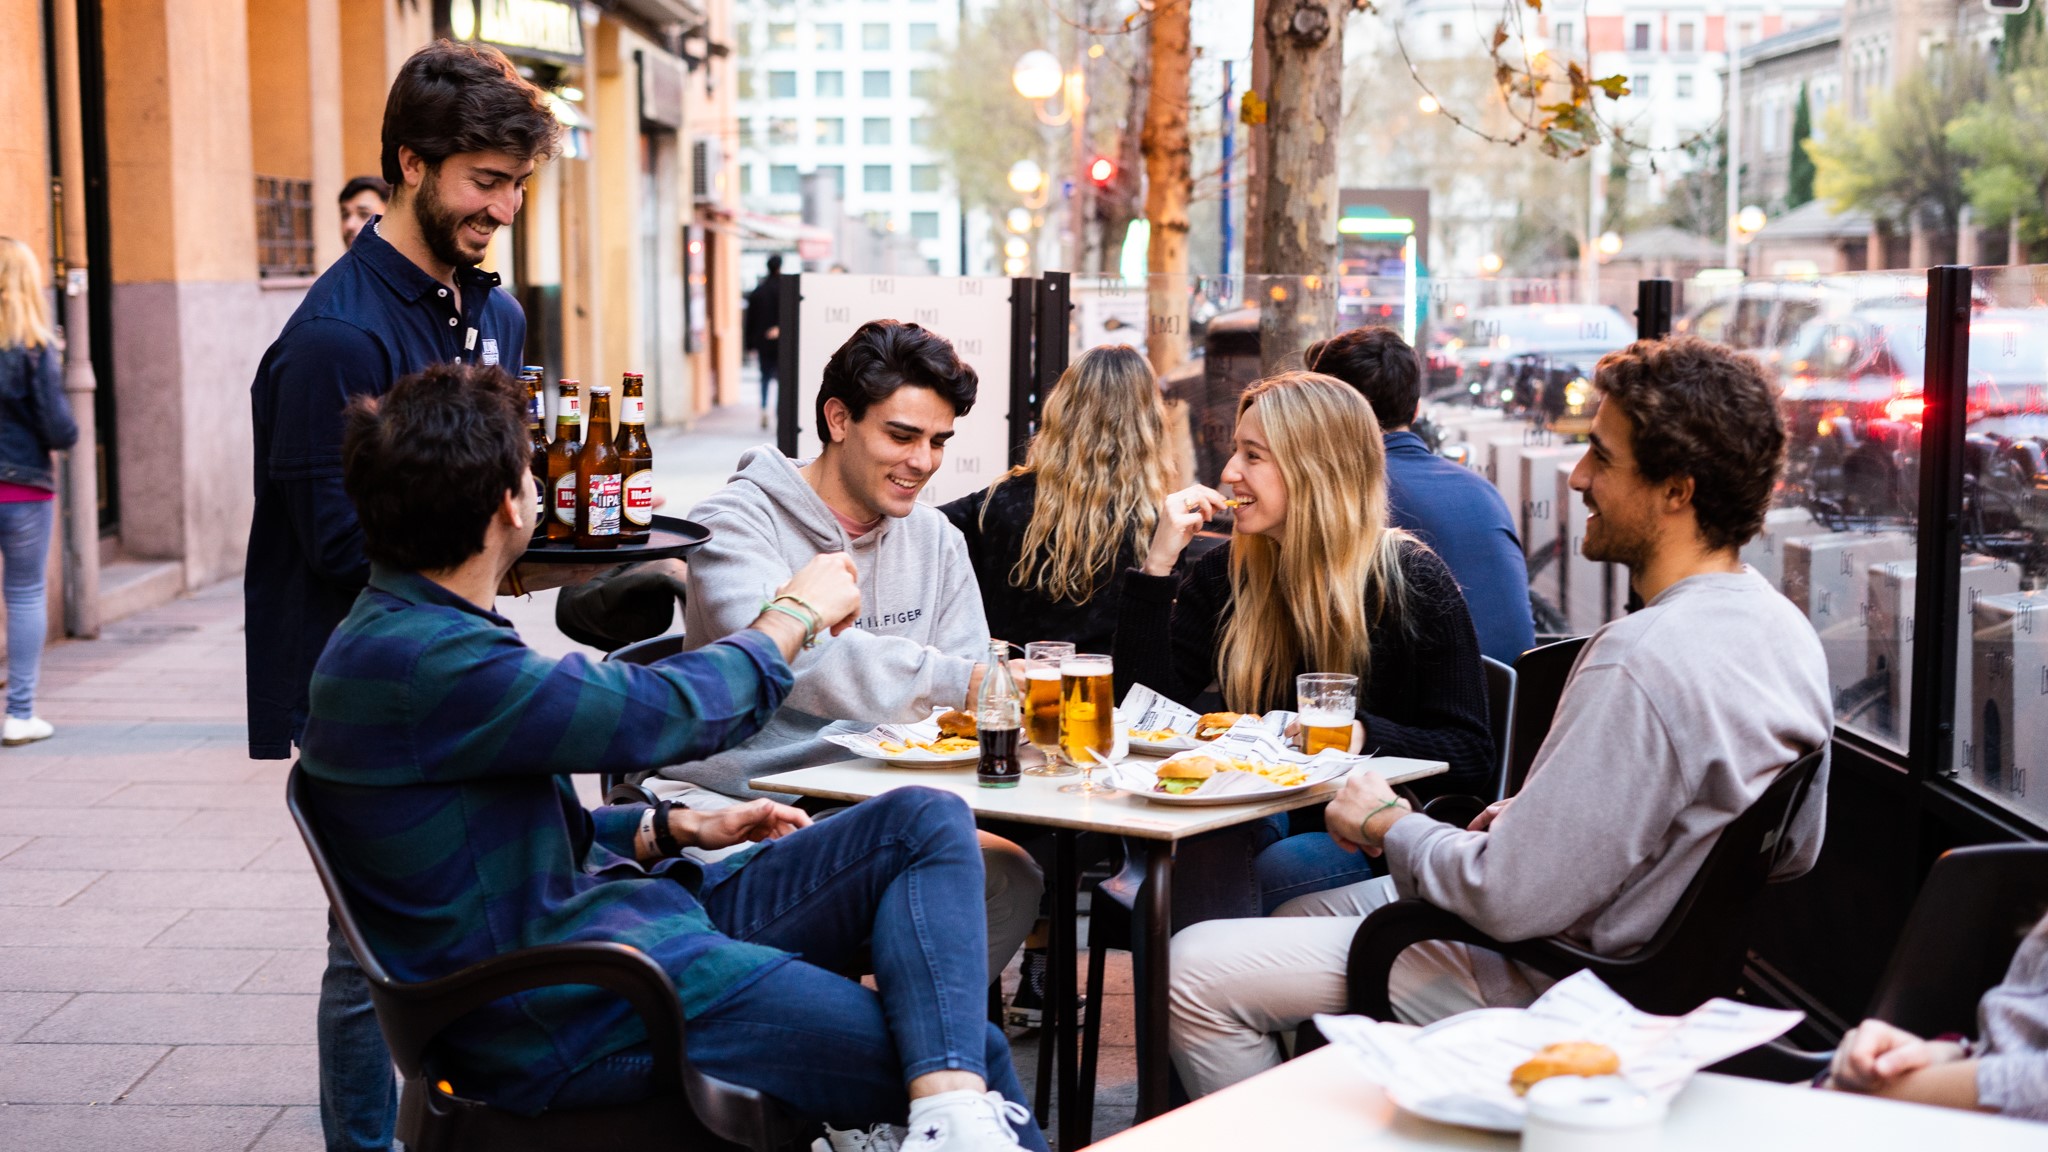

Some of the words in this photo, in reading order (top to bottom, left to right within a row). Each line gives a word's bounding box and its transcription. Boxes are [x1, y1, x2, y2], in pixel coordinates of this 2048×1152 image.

[870, 279, 895, 294] [M]
[959, 280, 983, 295] [M]
[825, 307, 849, 323] [M]
[914, 309, 939, 324] [M]
[1151, 314, 1180, 335] [M]
[1578, 320, 1608, 339] [M]
[958, 339, 982, 355] [M]
[956, 457, 980, 473] [M]
